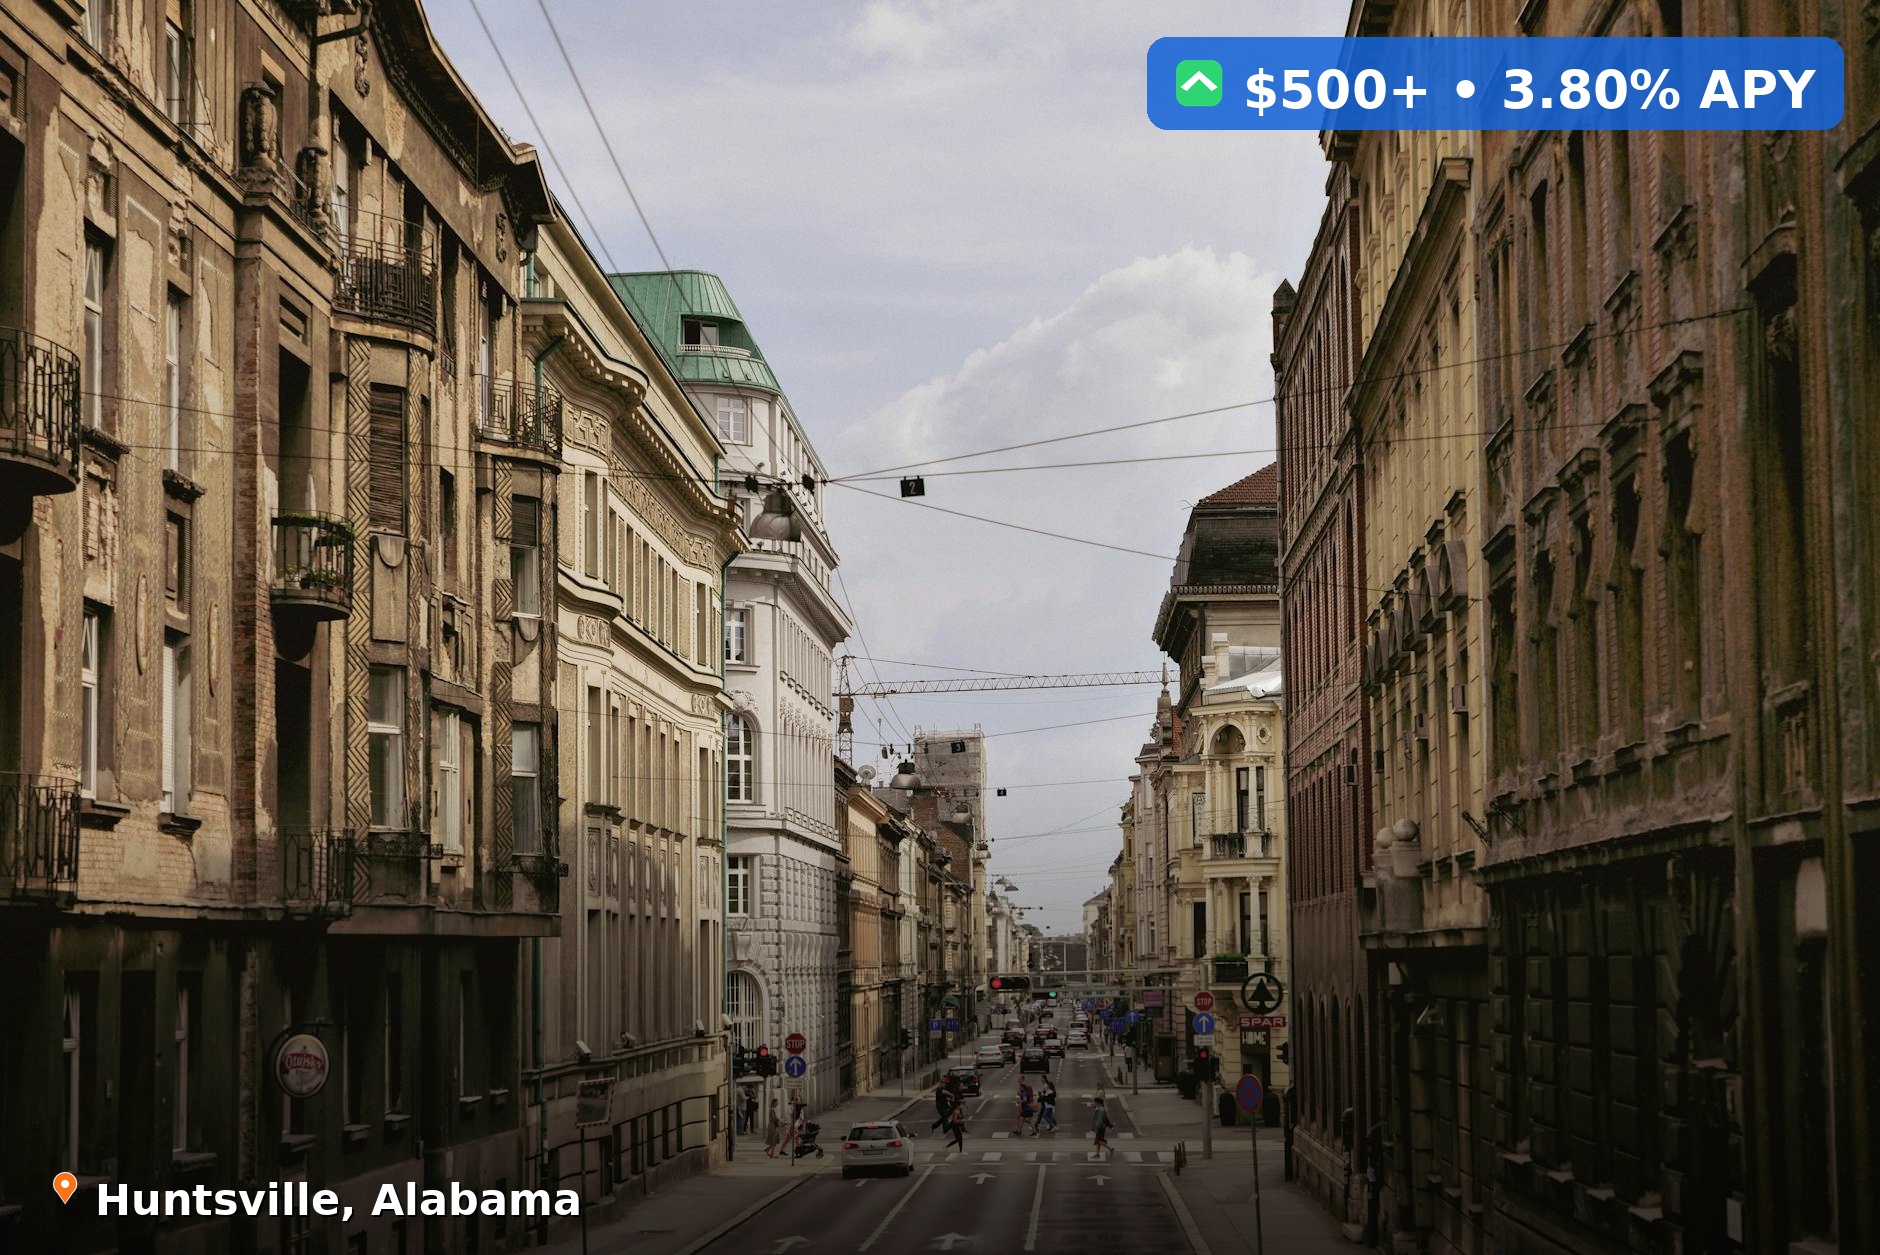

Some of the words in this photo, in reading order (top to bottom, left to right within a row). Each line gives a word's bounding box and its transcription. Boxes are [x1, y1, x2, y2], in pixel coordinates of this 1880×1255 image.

[1196, 997, 1213, 1006] STOP
[1241, 1017, 1284, 1027] SPAR
[1242, 1031, 1267, 1045] HOME
[786, 1039, 805, 1049] STOP
